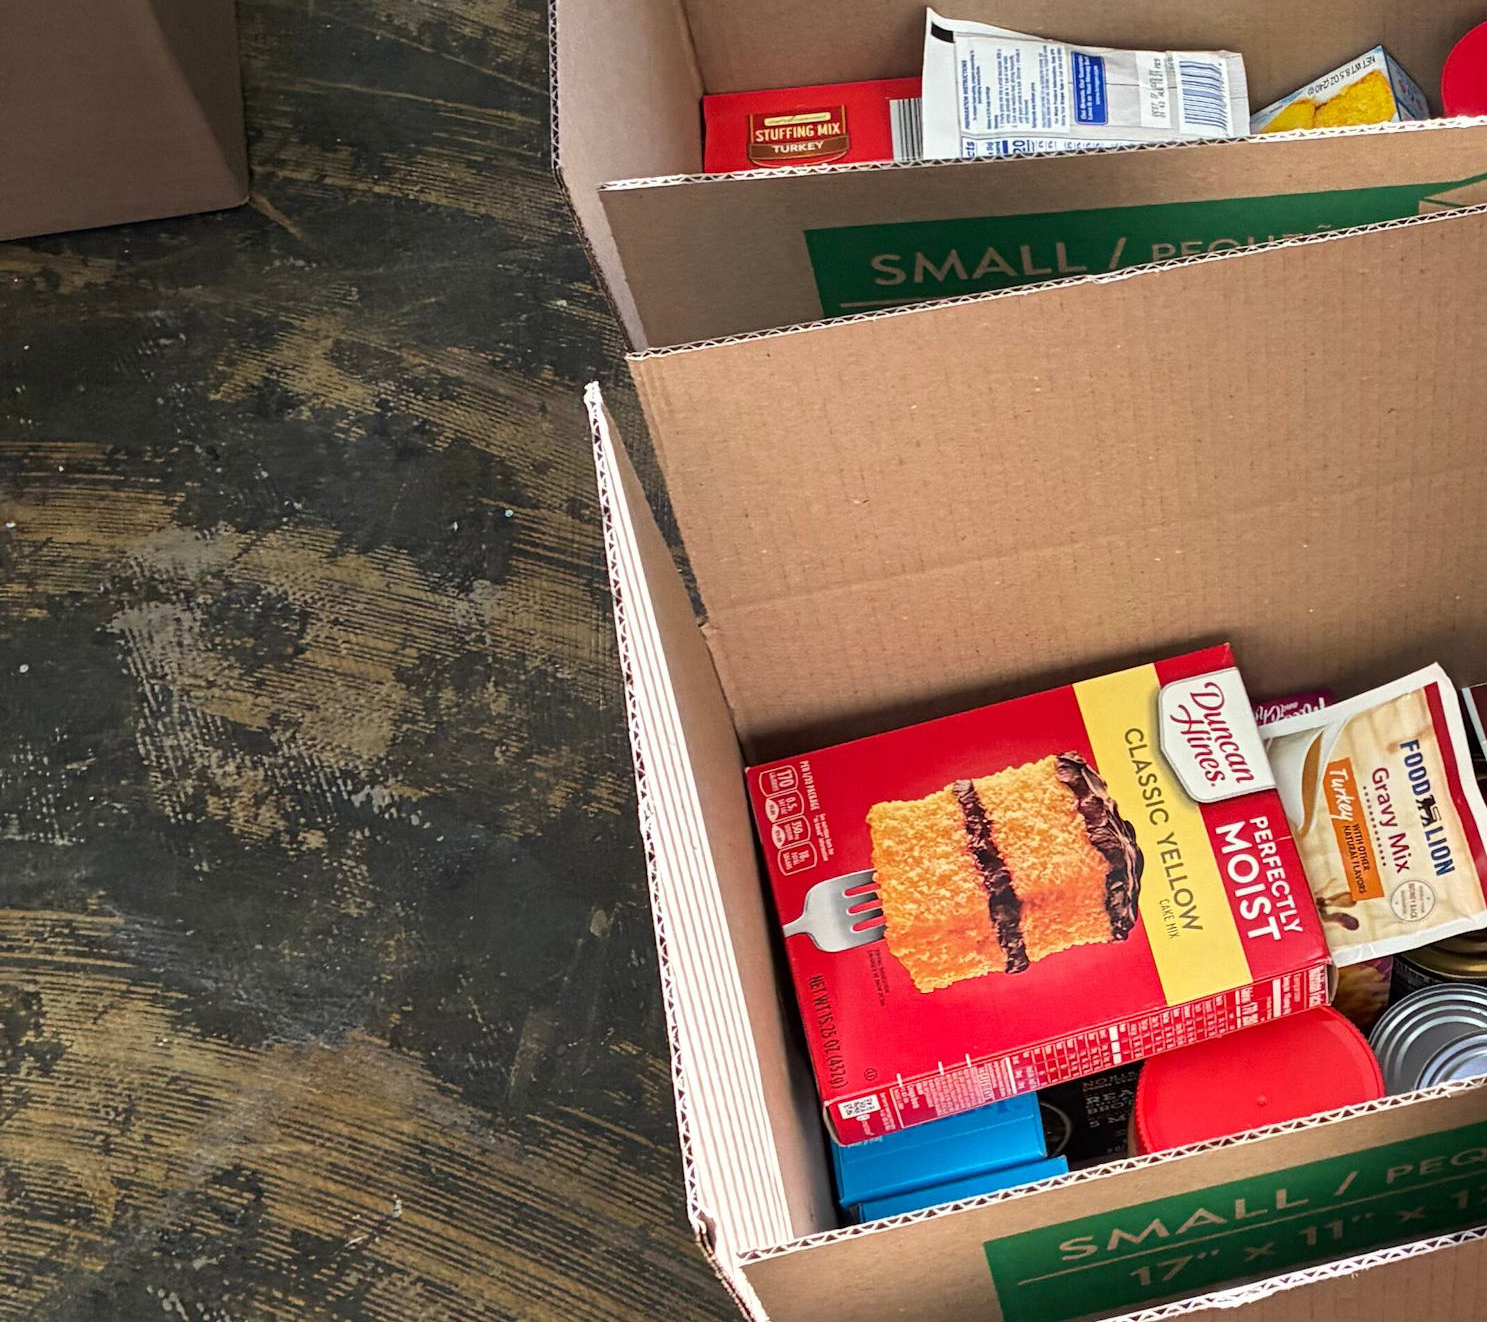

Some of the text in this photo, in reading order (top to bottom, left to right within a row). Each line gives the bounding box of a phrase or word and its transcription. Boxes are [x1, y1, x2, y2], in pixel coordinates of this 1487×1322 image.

[754, 122, 840, 142] STUFFING MIX
[772, 139, 824, 153] TURKEY
[870, 233, 1088, 294] SMALL
[1188, 682, 1255, 785] Duncan
[775, 768, 794, 788] 170
[1318, 766, 1359, 825] Turkey
[1399, 738, 1455, 876] FOOD LION
[1124, 728, 1202, 931] CLASSIC YELLOW
[1351, 823, 1370, 871] WITH OTHER
[1366, 766, 1414, 873] Gravy Mix
[1216, 822, 1281, 941] MOIST
[1252, 816, 1303, 932] PERFECTLY
[1341, 824, 1367, 893] NATURAL FLAVORS
[807, 974, 849, 1089] NET WT 15.25 OZ (432g)
[1057, 1179, 1309, 1263] SMALL
[1240, 1239, 1280, 1264] x
[1396, 1202, 1429, 1225] x
